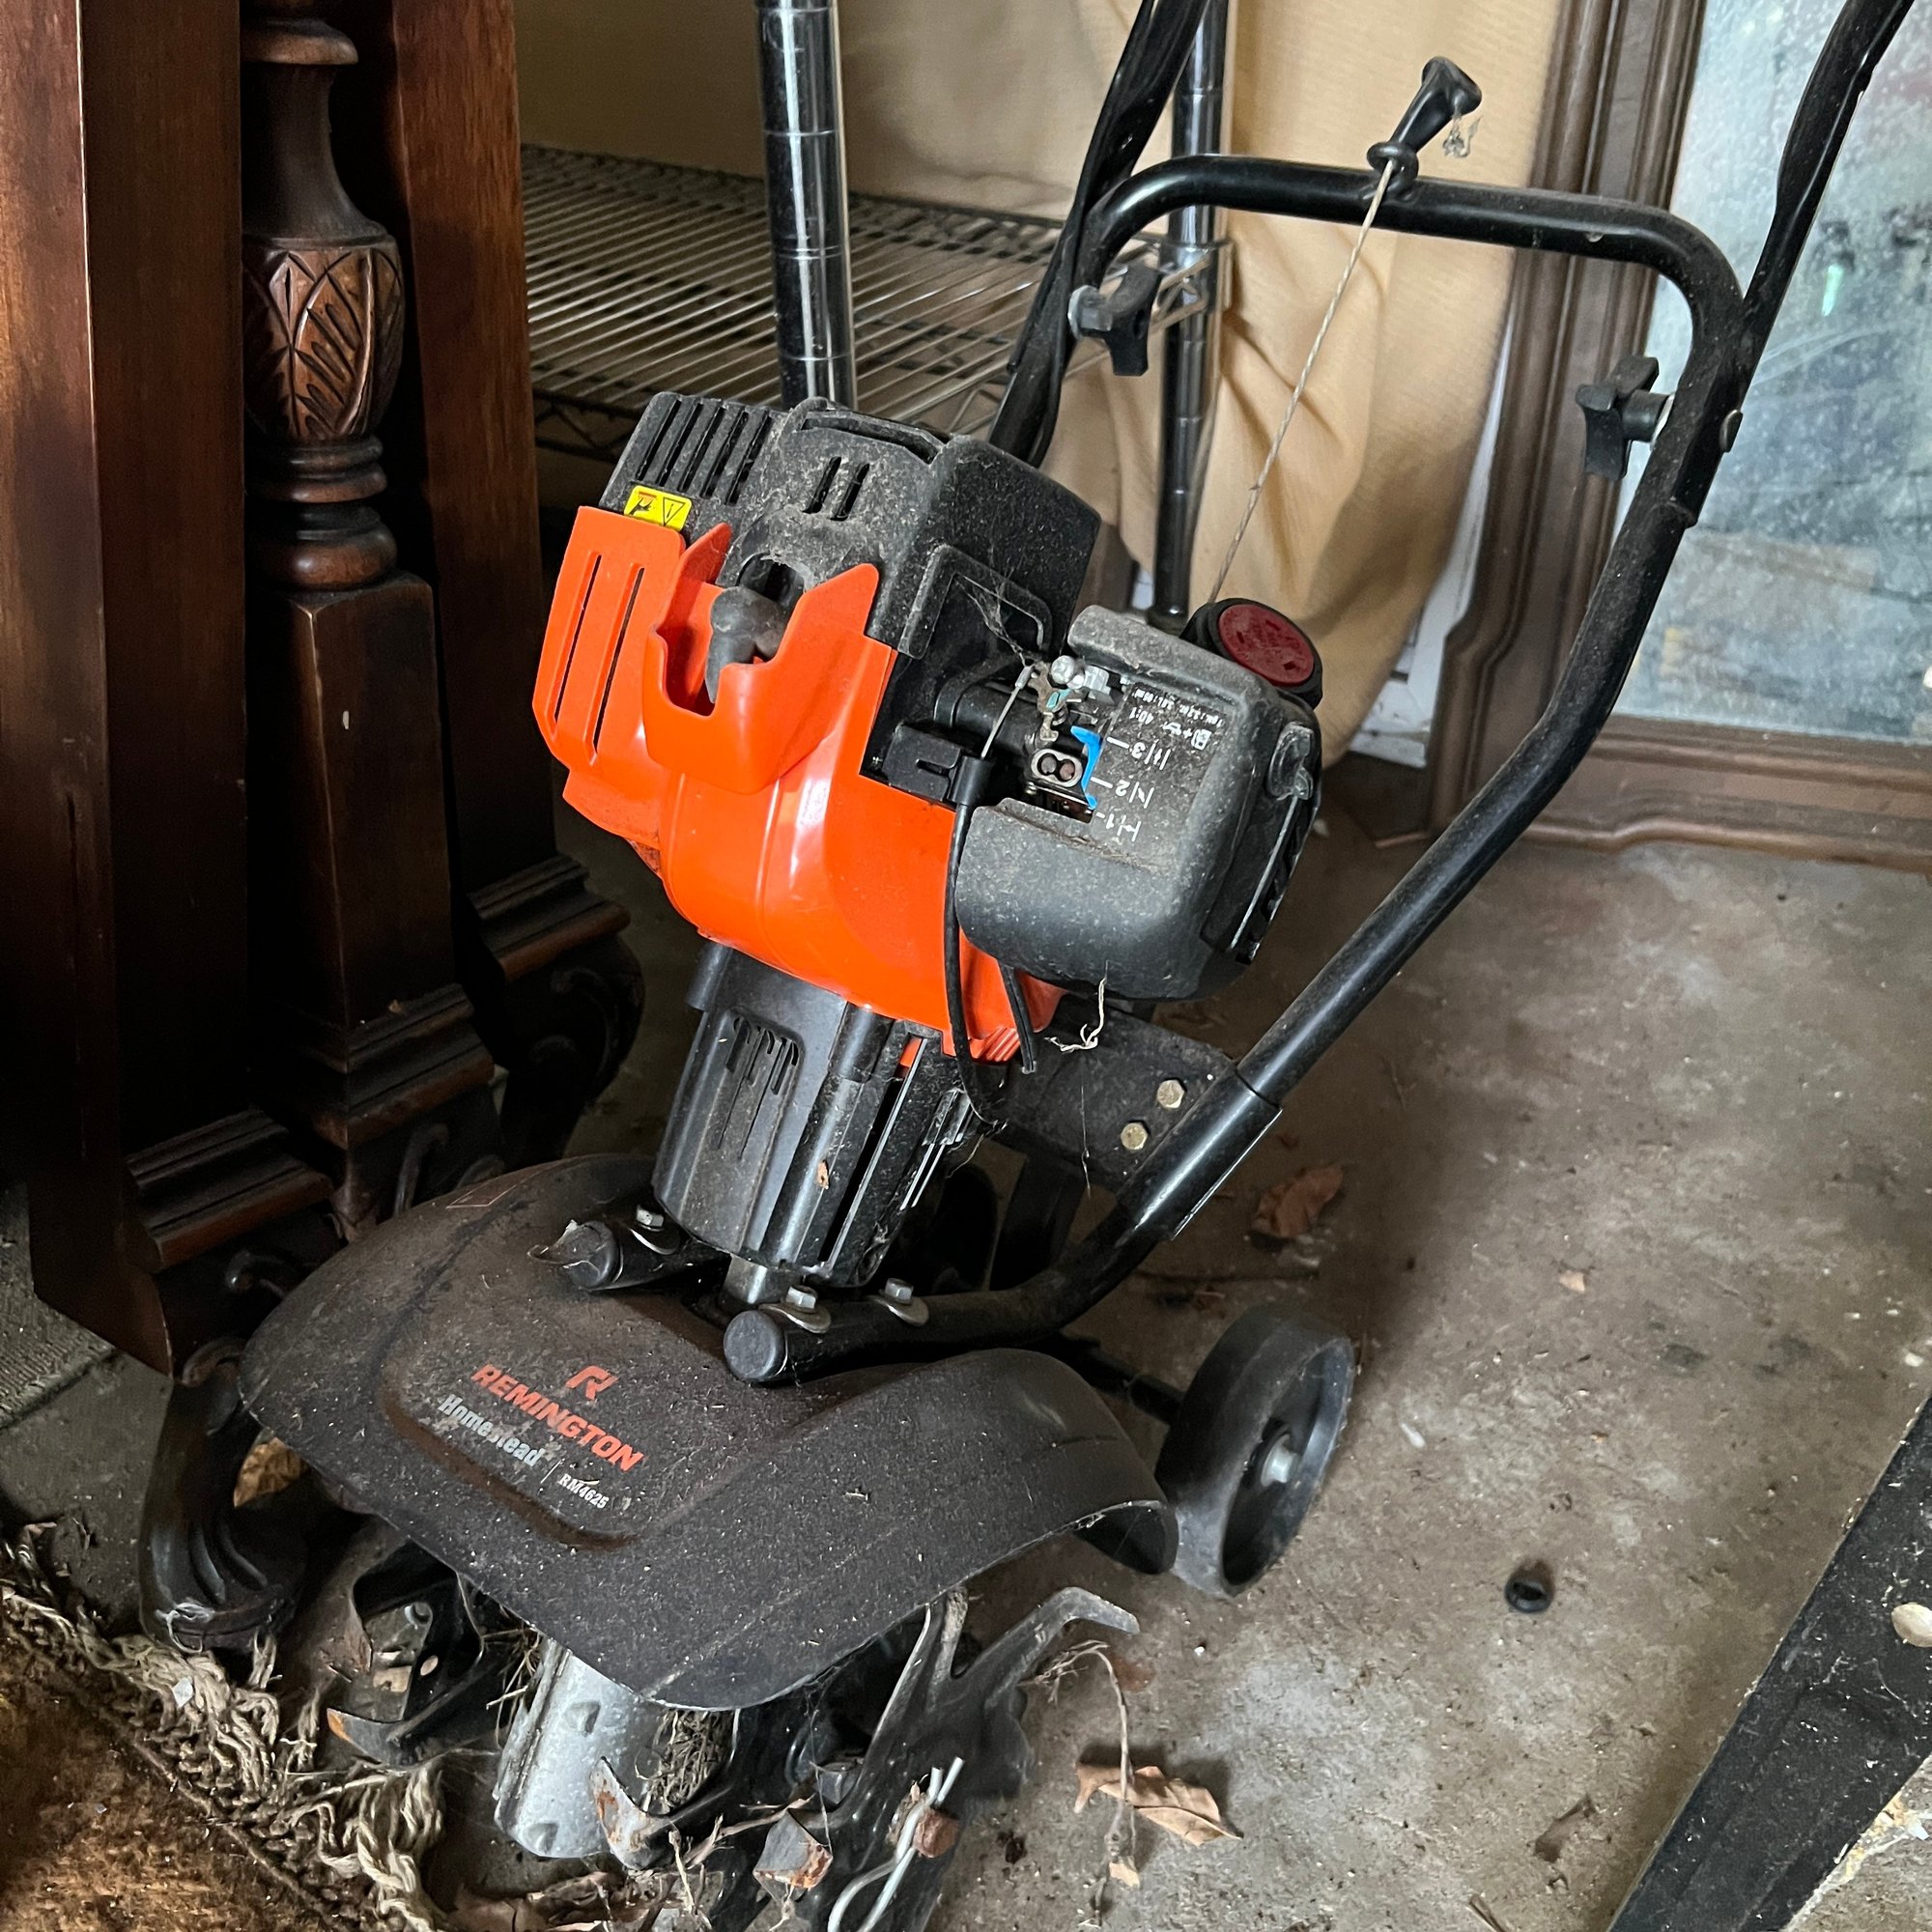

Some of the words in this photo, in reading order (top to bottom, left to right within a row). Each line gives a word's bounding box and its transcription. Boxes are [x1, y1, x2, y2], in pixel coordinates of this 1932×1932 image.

[1128, 706, 1154, 725] 40:1
[1130, 742, 1147, 759] 3
[1115, 779, 1130, 797] 2
[1105, 813, 1115, 830] 1
[470, 1363, 644, 1472] REMINGTON
[557, 1473, 610, 1509] RM4625
